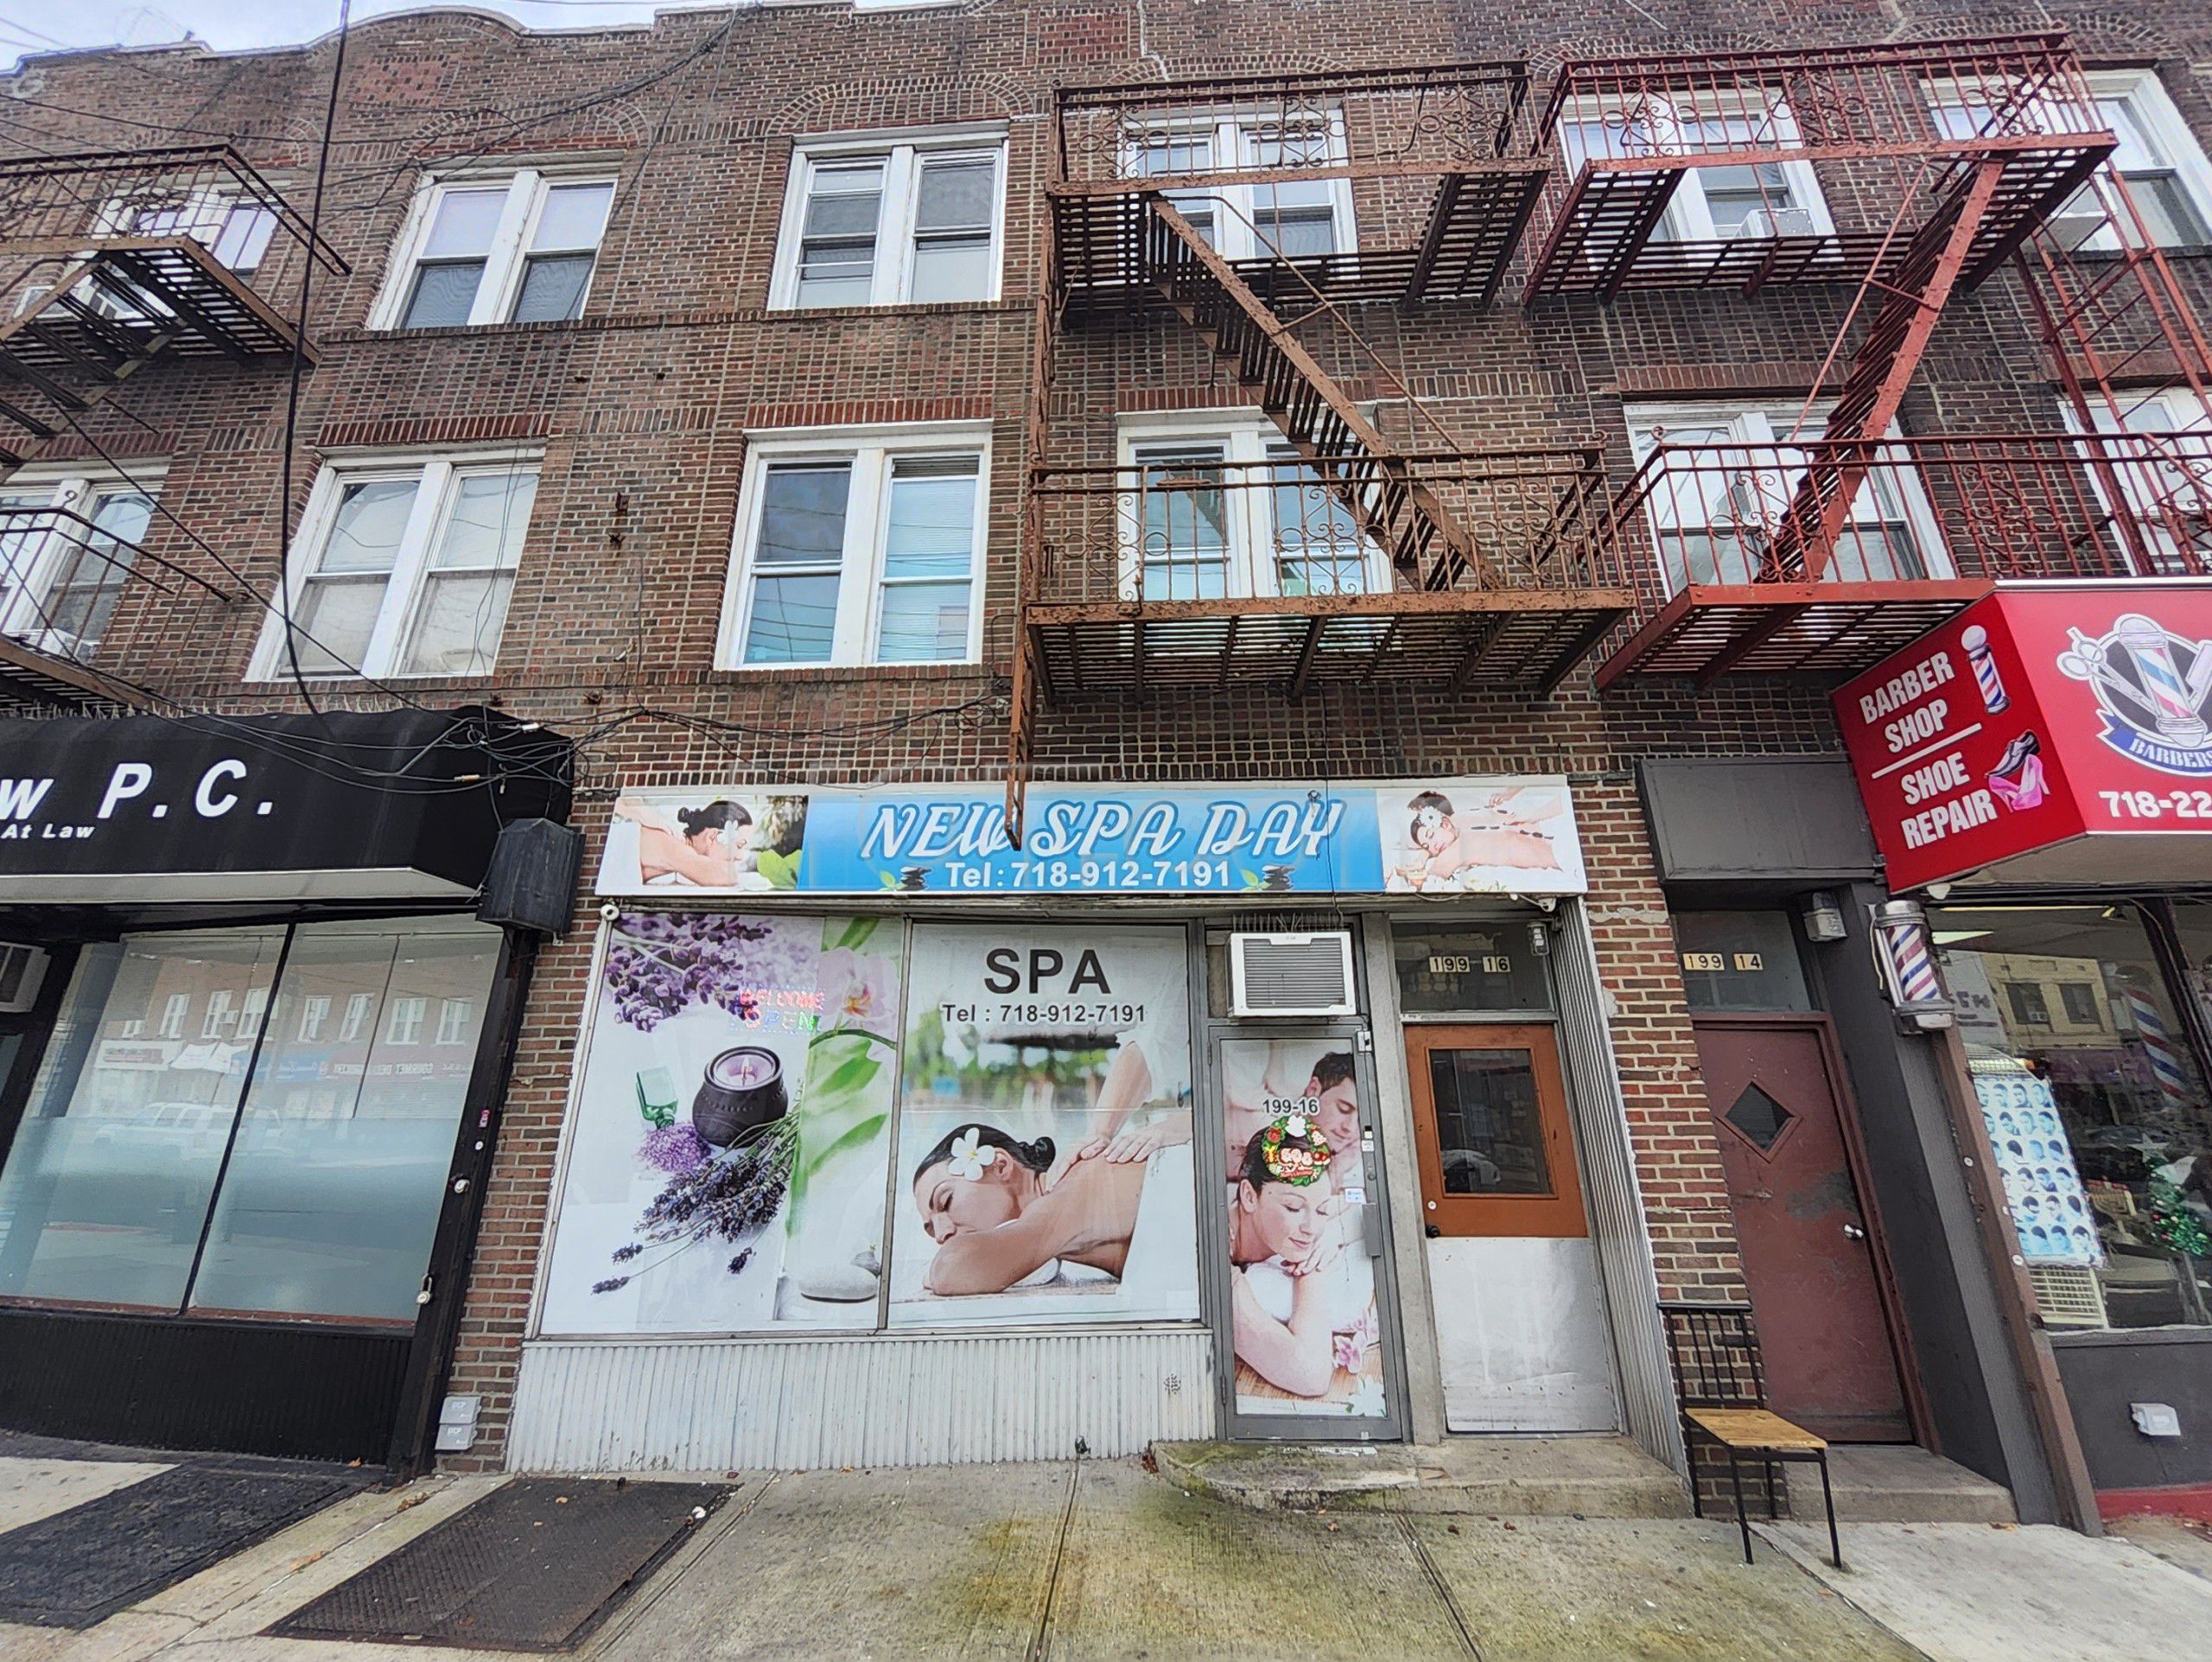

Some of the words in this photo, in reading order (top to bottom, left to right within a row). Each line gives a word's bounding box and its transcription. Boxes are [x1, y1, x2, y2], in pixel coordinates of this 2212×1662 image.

[1859, 652, 1955, 724] BARBER
[1885, 698, 1948, 753] SHOP
[1901, 752, 1971, 806] SHOE
[1901, 788, 1999, 850] REPAIR
[2098, 790, 2212, 818] 718-22
[0, 824, 32, 838] At
[42, 824, 95, 838] Law
[860, 804, 1013, 858] NEW
[1030, 801, 1181, 857] SPA
[1196, 802, 1344, 856] DAY
[984, 948, 1112, 995] SPA
[1682, 953, 1724, 970] 199
[1734, 953, 1763, 970] 14
[1001, 1004, 1145, 1023] 718-912-7191
[1262, 1098, 1319, 1113] 199-16
